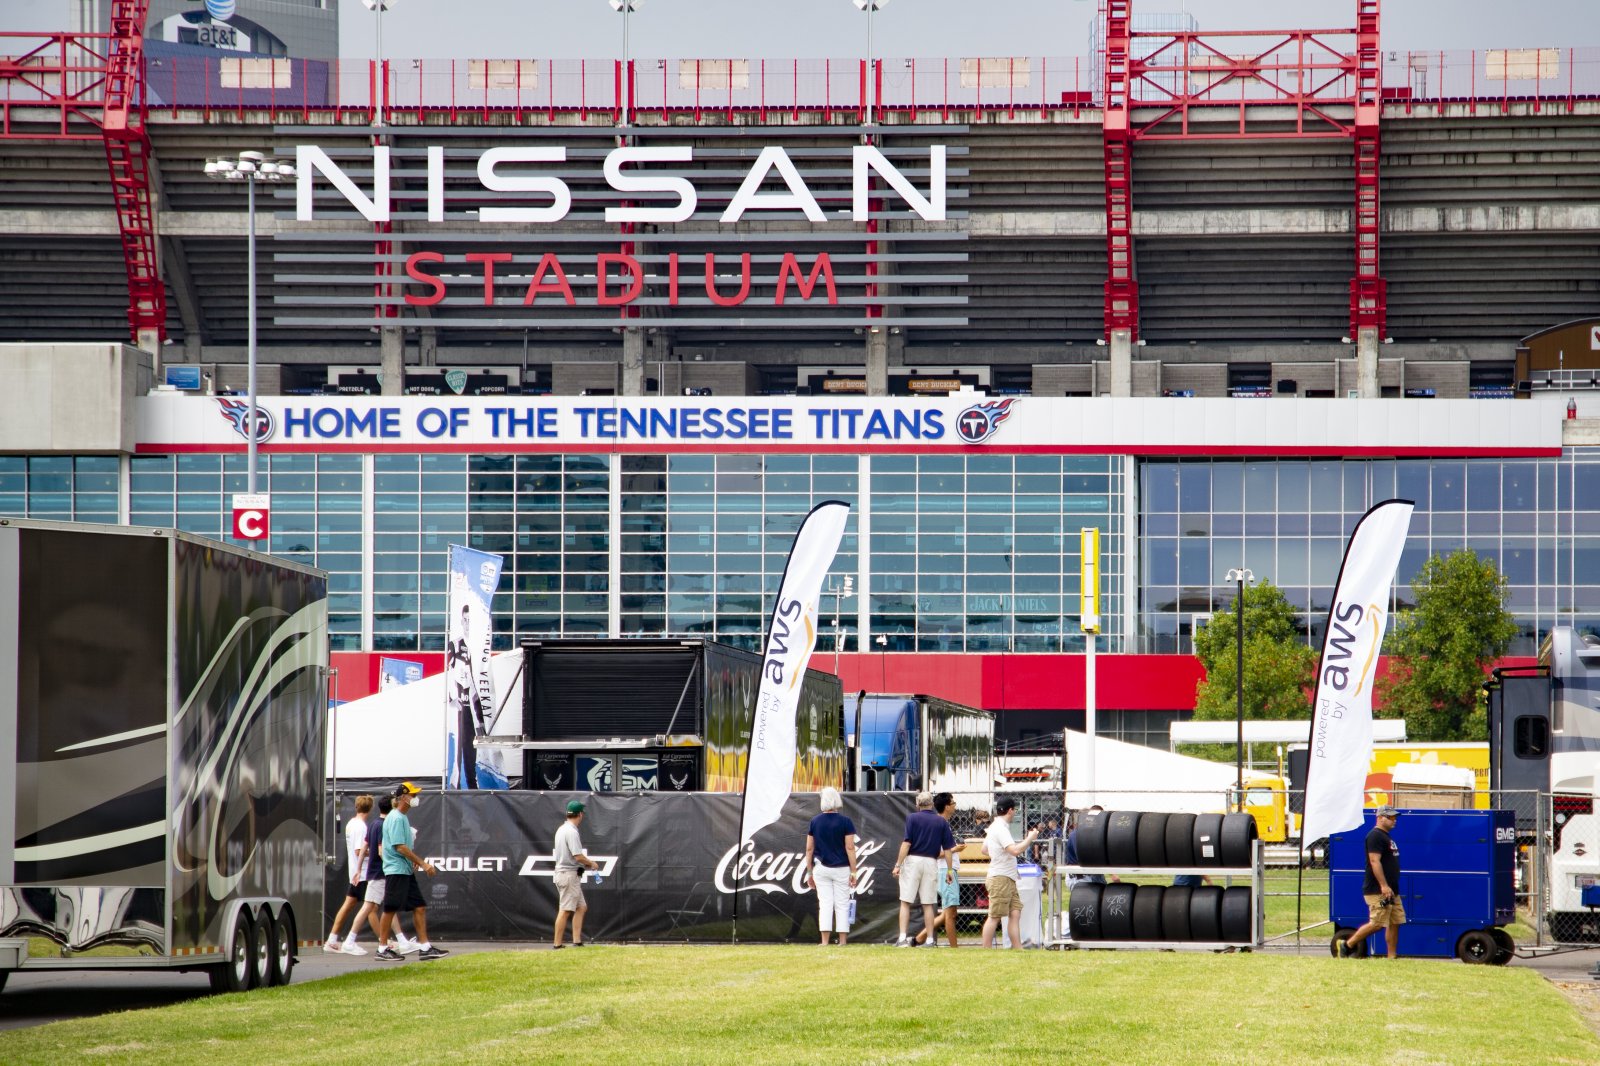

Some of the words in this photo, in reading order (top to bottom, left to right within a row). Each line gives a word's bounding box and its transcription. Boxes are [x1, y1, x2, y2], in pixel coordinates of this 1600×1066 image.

[296, 144, 947, 223] NISSAN
[404, 251, 838, 306] STADIUM
[284, 407, 401, 438] HOME
[417, 407, 470, 438] OF
[484, 407, 558, 438] THE
[573, 407, 793, 439] TENNESSEE
[808, 408, 945, 439] TITANS
[238, 510, 264, 538] C
[969, 595, 999, 611] JACK
[764, 597, 802, 685] aws
[1323, 601, 1364, 692] aws
[479, 671, 492, 719] VEEKAY
[770, 695, 782, 713] by
[1331, 701, 1348, 720] by
[756, 691, 770, 750] powered
[1316, 698, 1330, 759] powered
[1496, 828, 1515, 840] GMG
